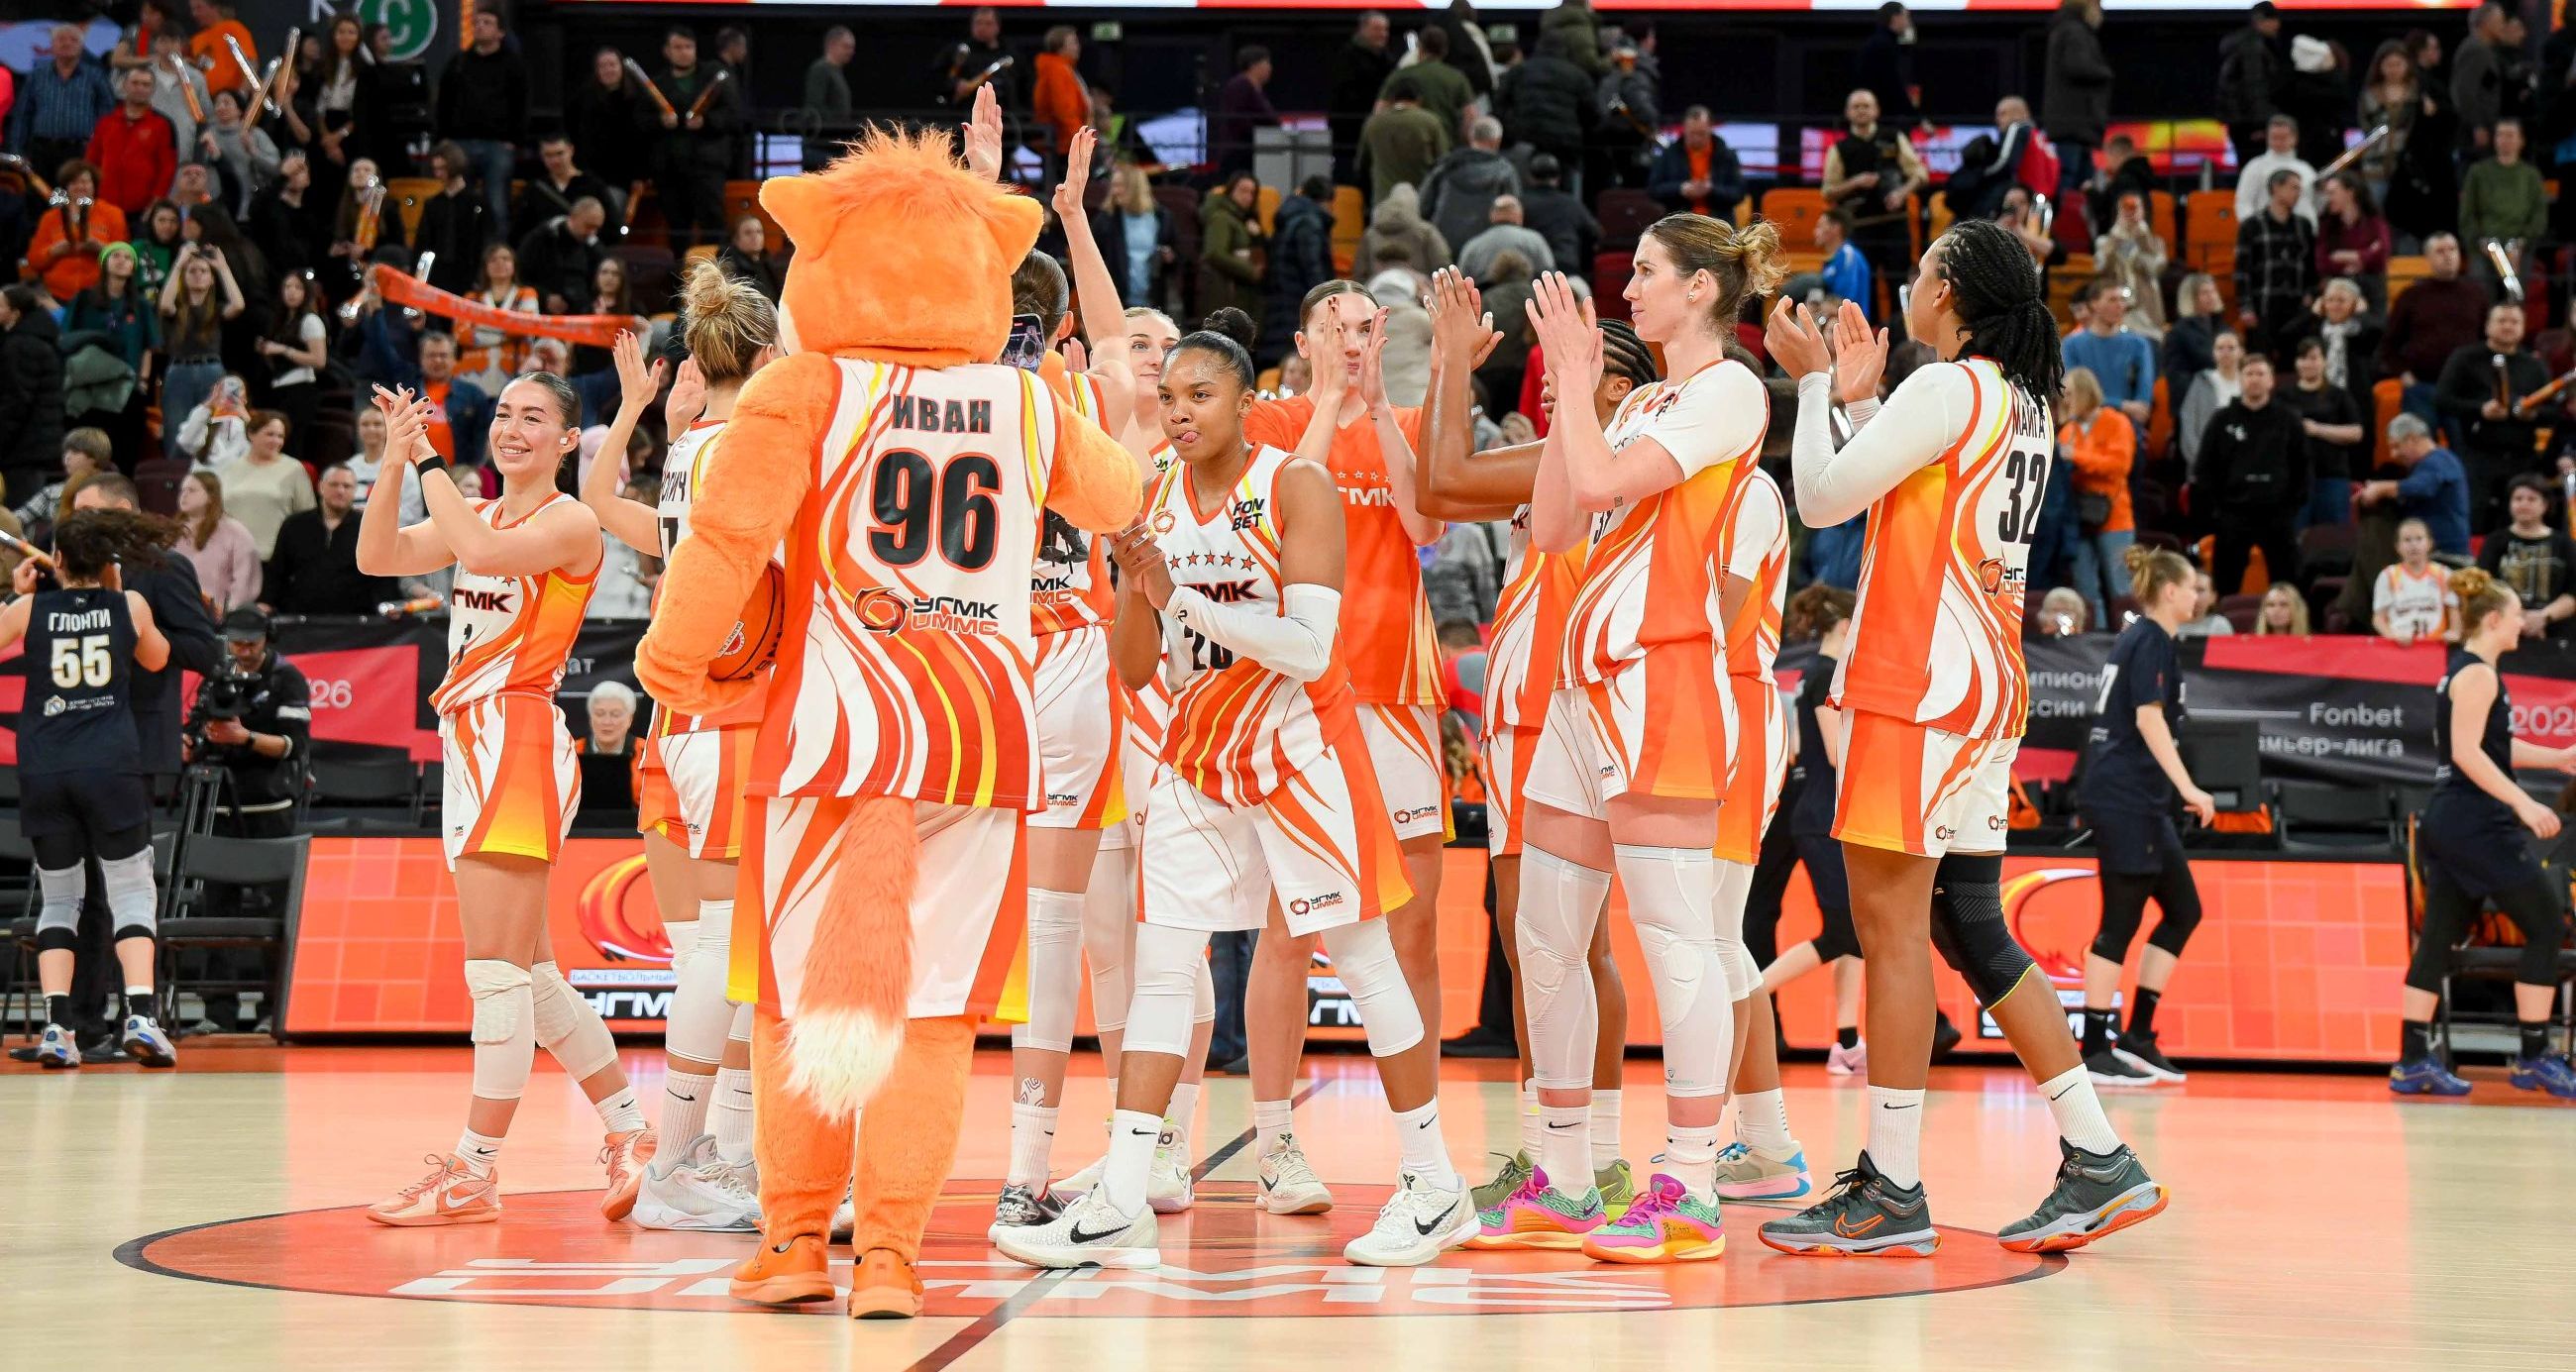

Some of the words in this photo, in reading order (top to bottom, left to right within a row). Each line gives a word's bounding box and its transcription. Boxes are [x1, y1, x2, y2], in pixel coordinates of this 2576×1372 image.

[892, 393, 991, 434] ИВАН
[1234, 497, 1265, 516] FON
[1998, 450, 2046, 544] 32
[867, 447, 1003, 574] 96
[1232, 513, 1263, 532] BET
[1030, 589, 1072, 604] MC
[1179, 579, 1263, 603] МК
[912, 596, 1000, 619] УГМК
[48, 608, 112, 633] ГЛОНТИ
[912, 612, 1000, 636] UMMC
[51, 634, 112, 689] 55
[2309, 700, 2405, 728] Fonbet
[2512, 705, 2576, 737] 202
[1047, 792, 1079, 801] УГМК
[1310, 891, 1342, 903] УГМК
[1312, 897, 1343, 910] UMMC
